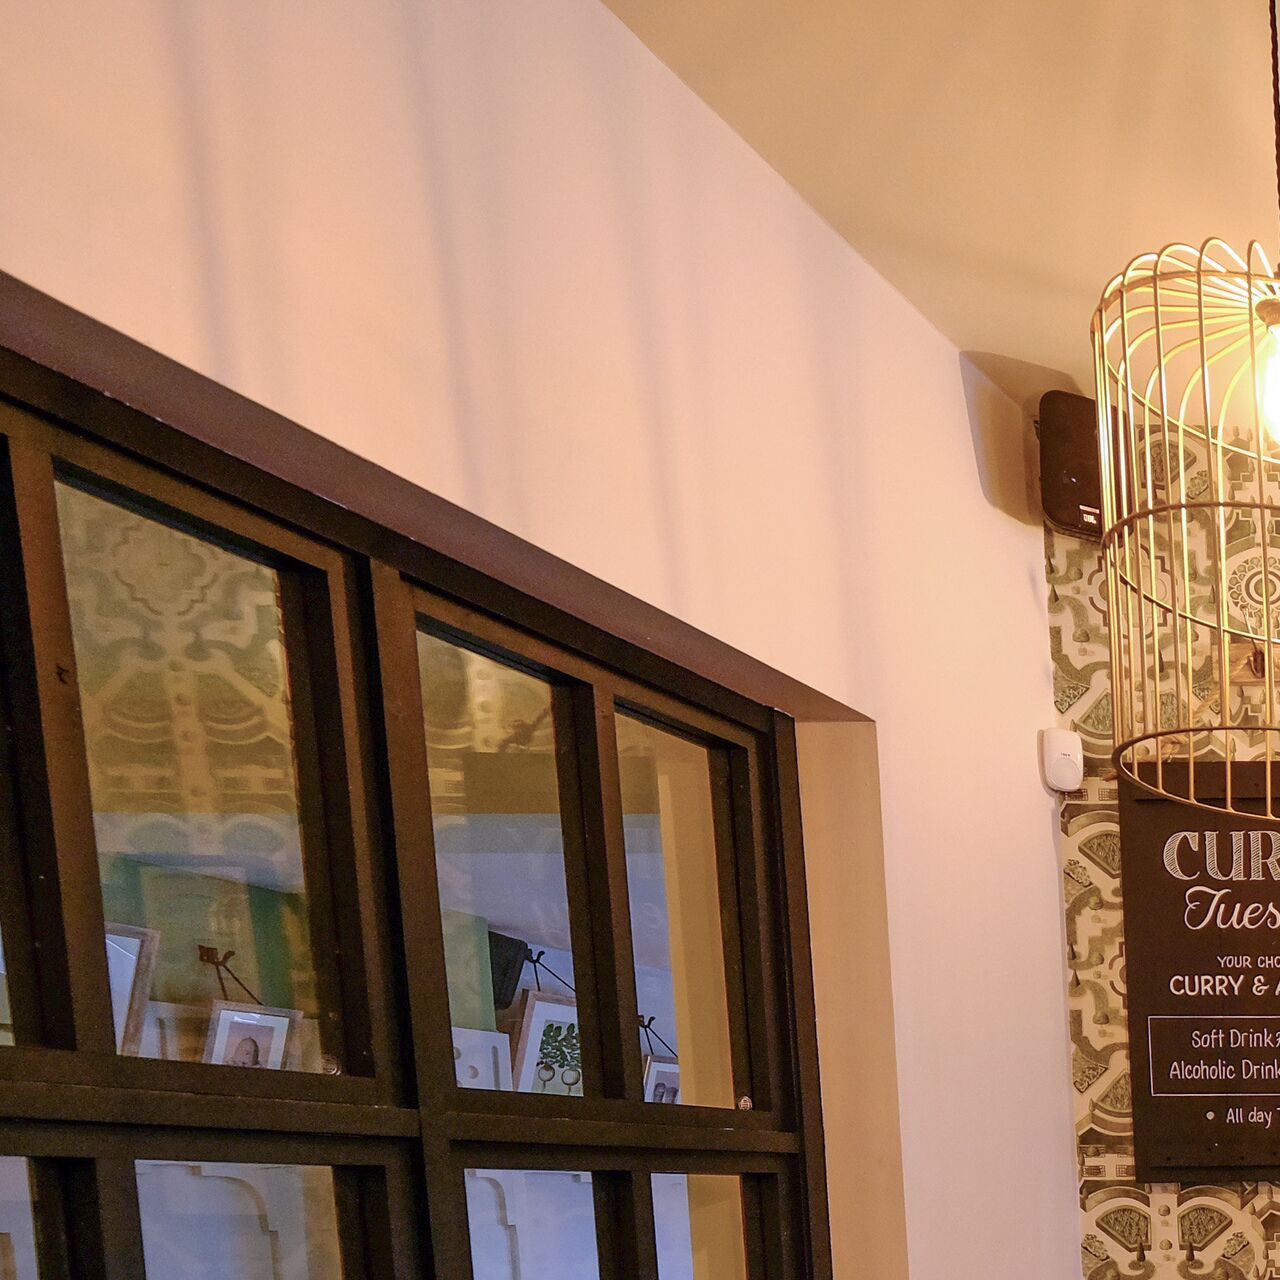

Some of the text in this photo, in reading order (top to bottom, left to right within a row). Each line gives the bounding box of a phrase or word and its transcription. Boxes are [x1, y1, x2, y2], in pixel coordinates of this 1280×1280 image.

[1217, 955, 1252, 969] YOUR
[1169, 974, 1244, 996] CURRY
[1252, 975, 1270, 996] &
[1191, 1029, 1225, 1048] Soft
[1230, 1028, 1274, 1048] Drink
[1169, 1059, 1236, 1080] Alcoholic
[1226, 1107, 1244, 1124] All
[1248, 1106, 1272, 1129] day
